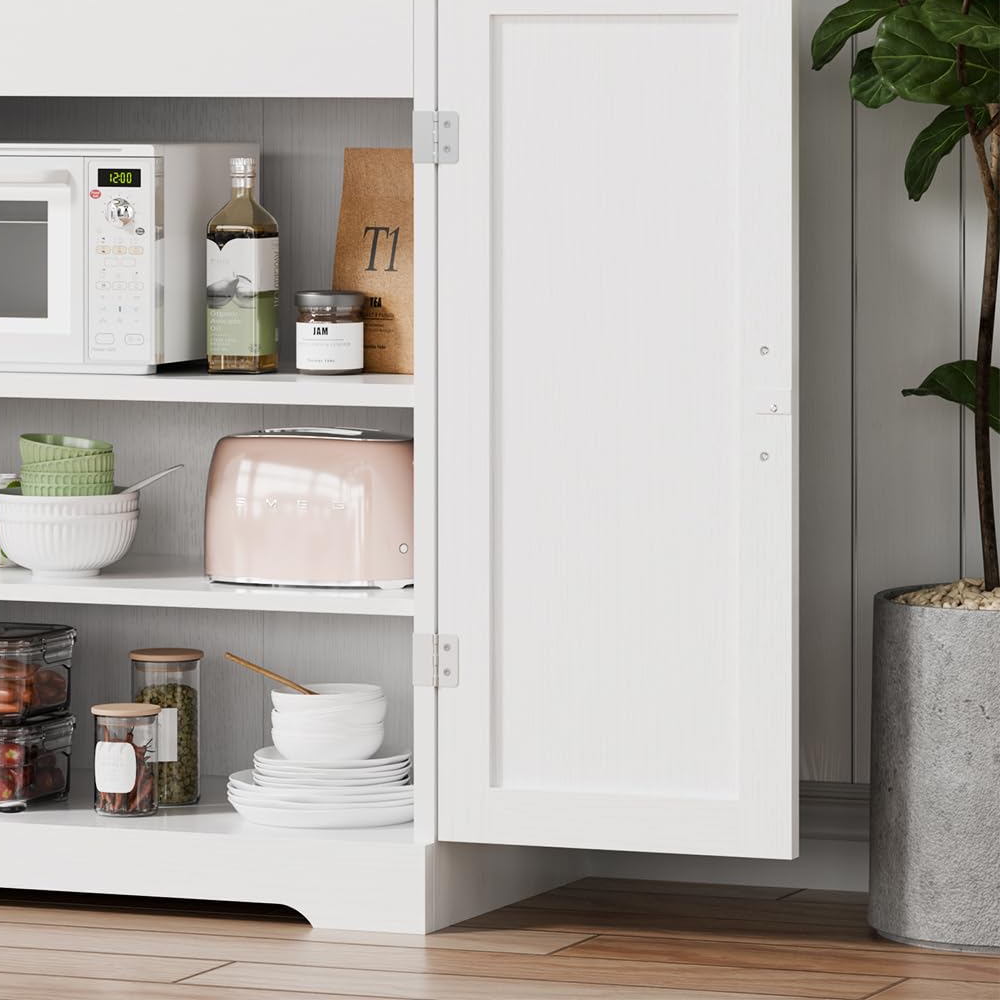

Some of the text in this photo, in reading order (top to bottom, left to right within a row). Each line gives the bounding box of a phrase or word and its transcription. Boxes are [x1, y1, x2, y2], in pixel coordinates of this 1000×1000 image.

[109, 172, 132, 184] 12:00
[363, 226, 401, 272] T1
[370, 297, 382, 308] TEA
[313, 327, 329, 335] JAM
